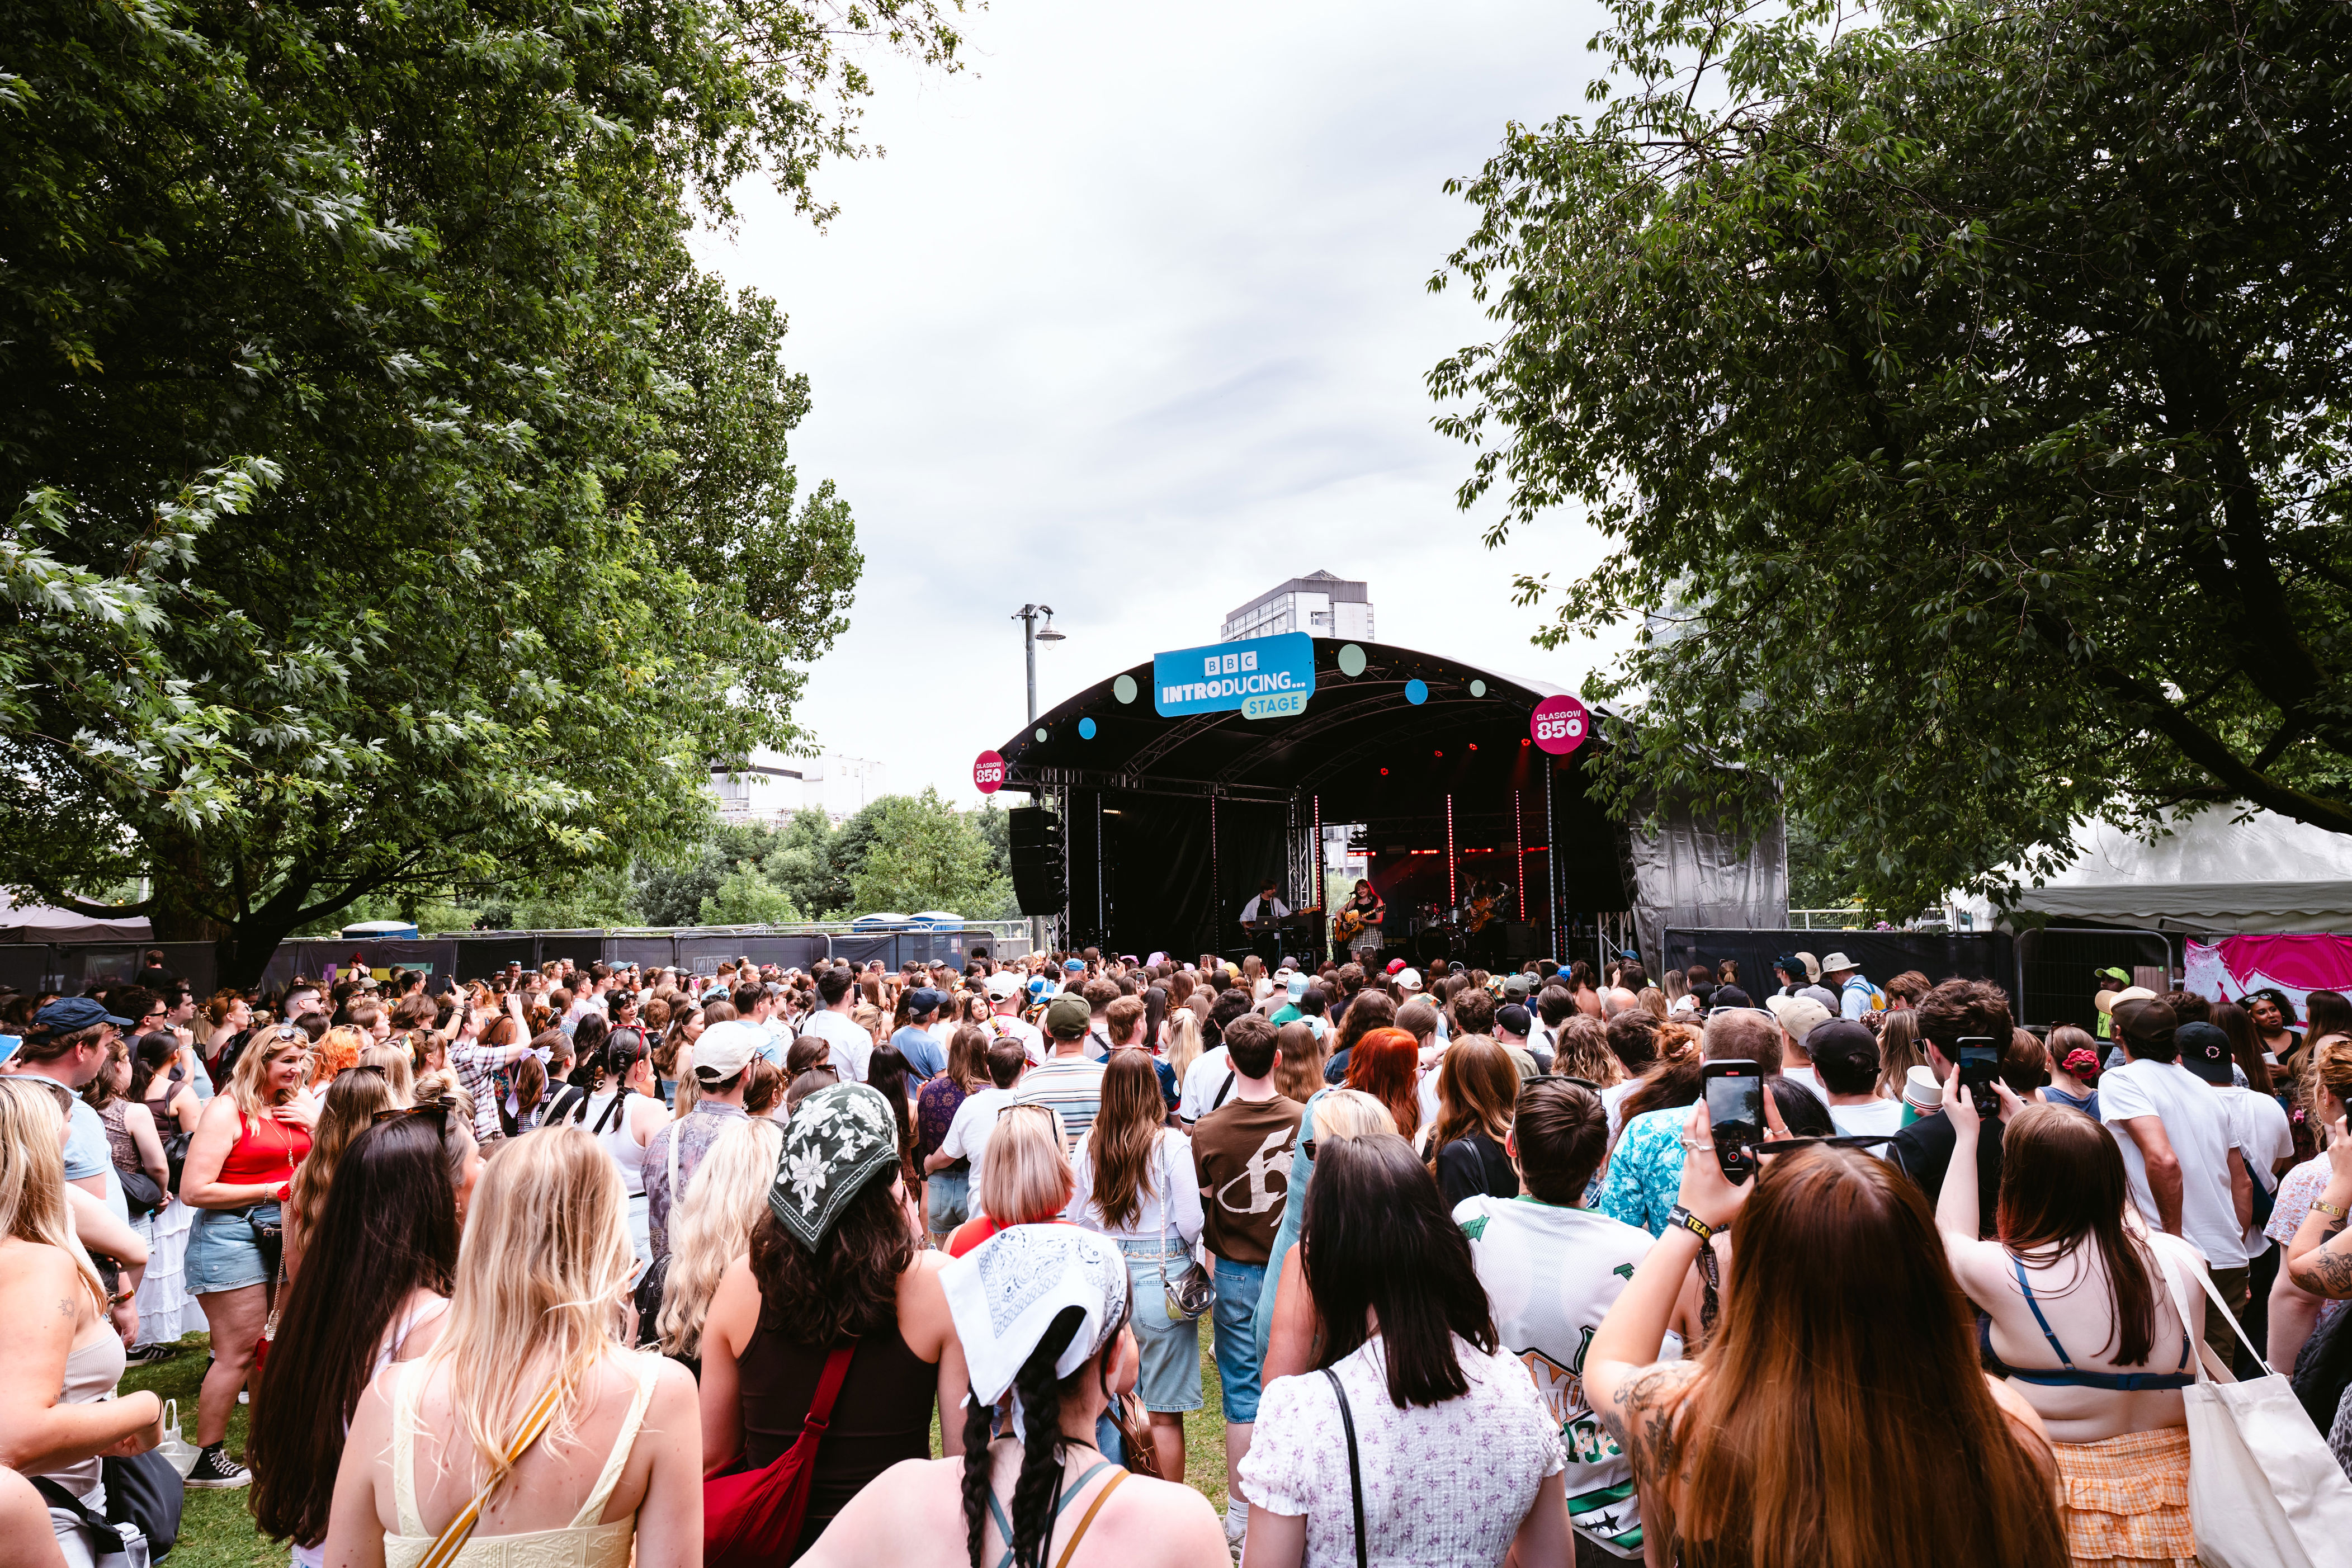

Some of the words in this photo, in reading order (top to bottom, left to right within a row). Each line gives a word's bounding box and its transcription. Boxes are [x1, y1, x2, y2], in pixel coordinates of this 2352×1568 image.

[1208, 654, 1254, 673] BBC
[1163, 671, 1306, 703] INTRODUCING...
[1249, 696, 1298, 715] STAGE
[1537, 710, 1581, 721] GLASGOW
[1537, 719, 1582, 739] 850
[976, 768, 1002, 783] 850
[1705, 1253, 1717, 1284] TRNSMT
